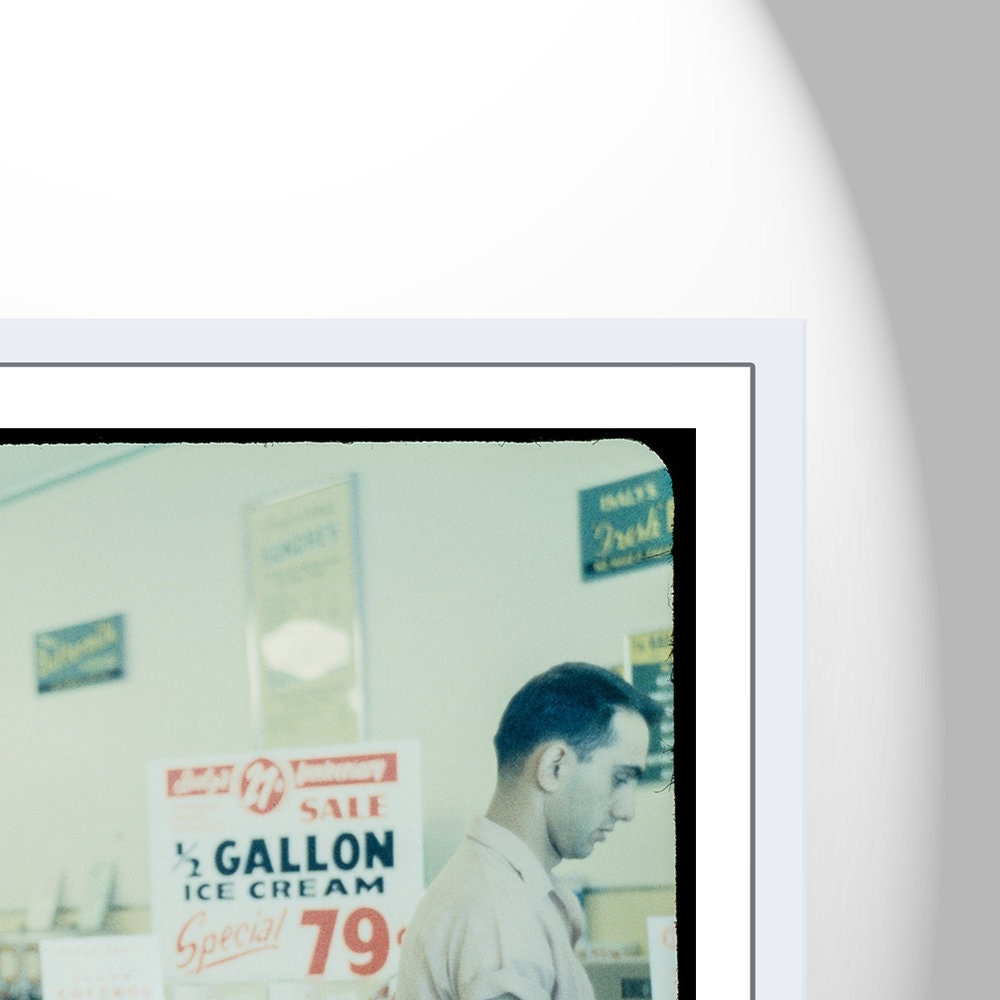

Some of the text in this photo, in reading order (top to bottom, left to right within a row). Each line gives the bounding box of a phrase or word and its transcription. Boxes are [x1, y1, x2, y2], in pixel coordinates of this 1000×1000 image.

[301, 794, 388, 822] SALE
[214, 830, 394, 876] GALLON
[184, 877, 385, 901] ICE CREAM
[175, 906, 287, 974] Special
